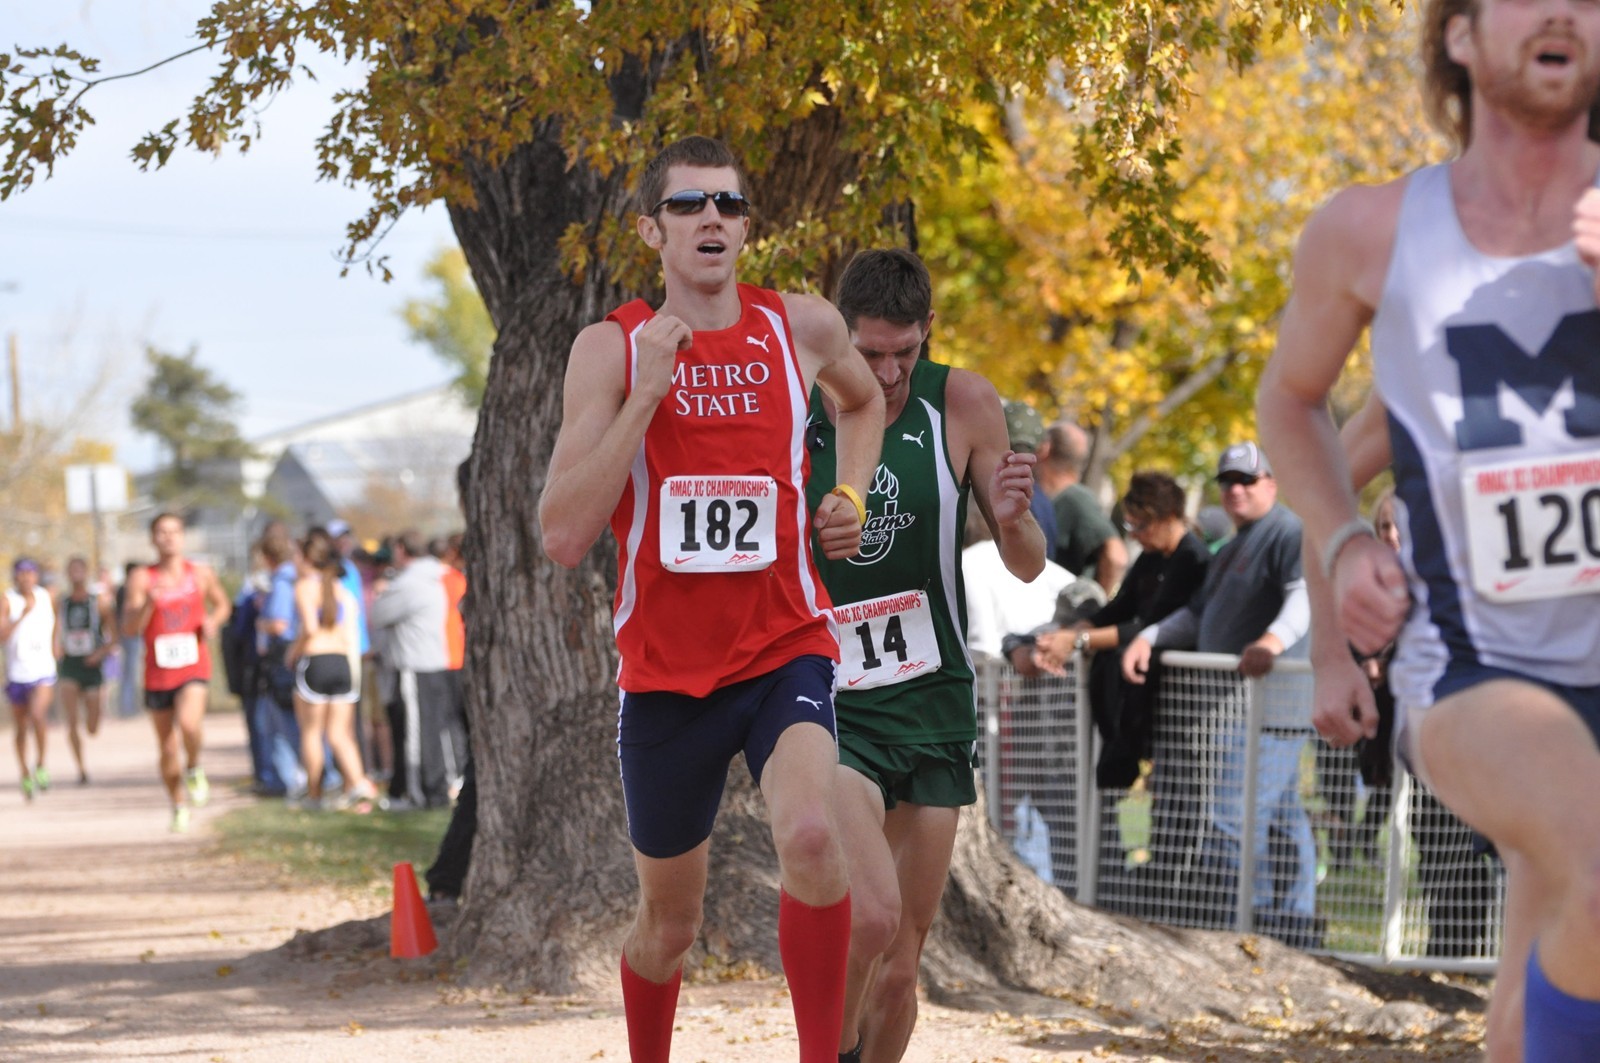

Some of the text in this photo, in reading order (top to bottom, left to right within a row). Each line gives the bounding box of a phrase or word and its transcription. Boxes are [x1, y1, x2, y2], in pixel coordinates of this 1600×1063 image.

[675, 389, 760, 417] STATE
[670, 480, 769, 497] RMAC XC CHAMPIONSHIPS
[680, 499, 760, 552] 182
[834, 592, 921, 625] MAC XC CHAMPIONSHIPS
[855, 614, 908, 671] 14
